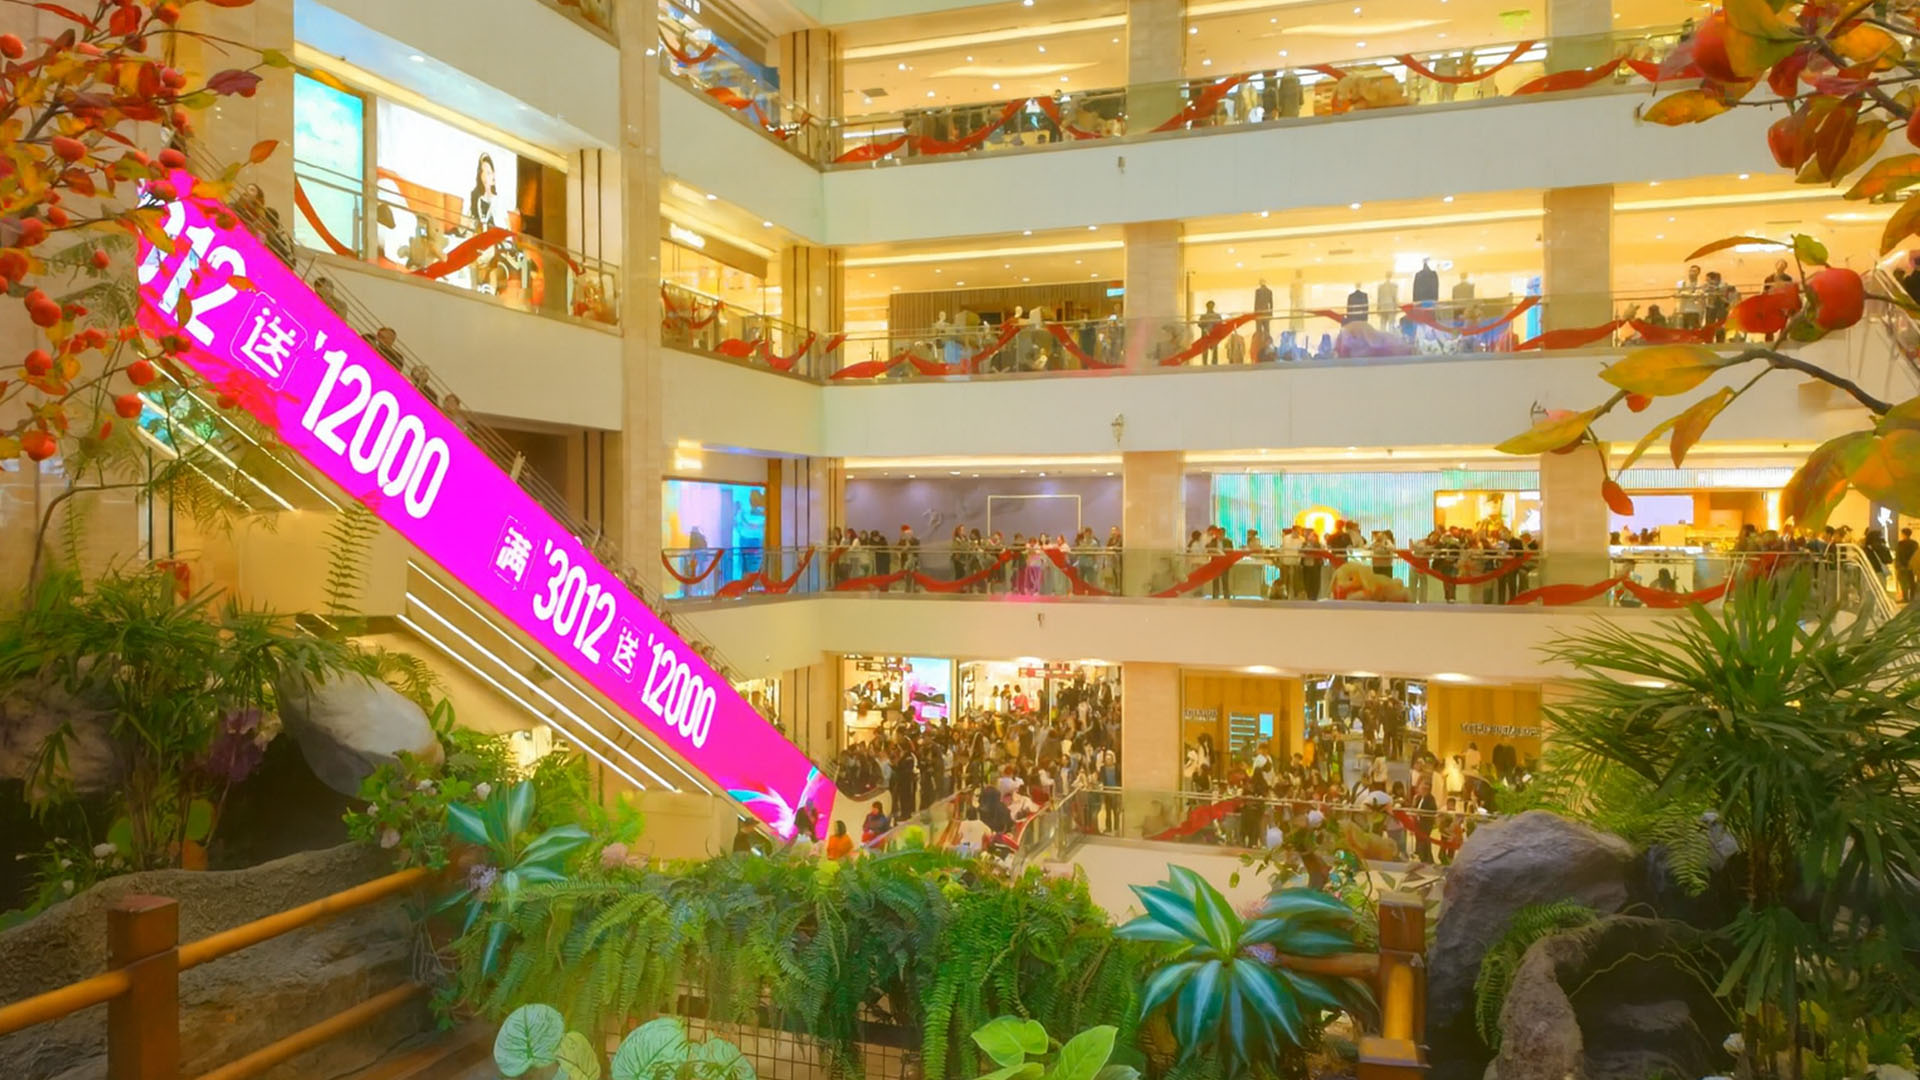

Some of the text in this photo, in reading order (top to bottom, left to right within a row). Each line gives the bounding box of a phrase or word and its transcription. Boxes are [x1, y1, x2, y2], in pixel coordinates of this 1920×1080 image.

[240, 307, 297, 378] 送
[495, 526, 533, 583] 满
[612, 626, 640, 675] 送
